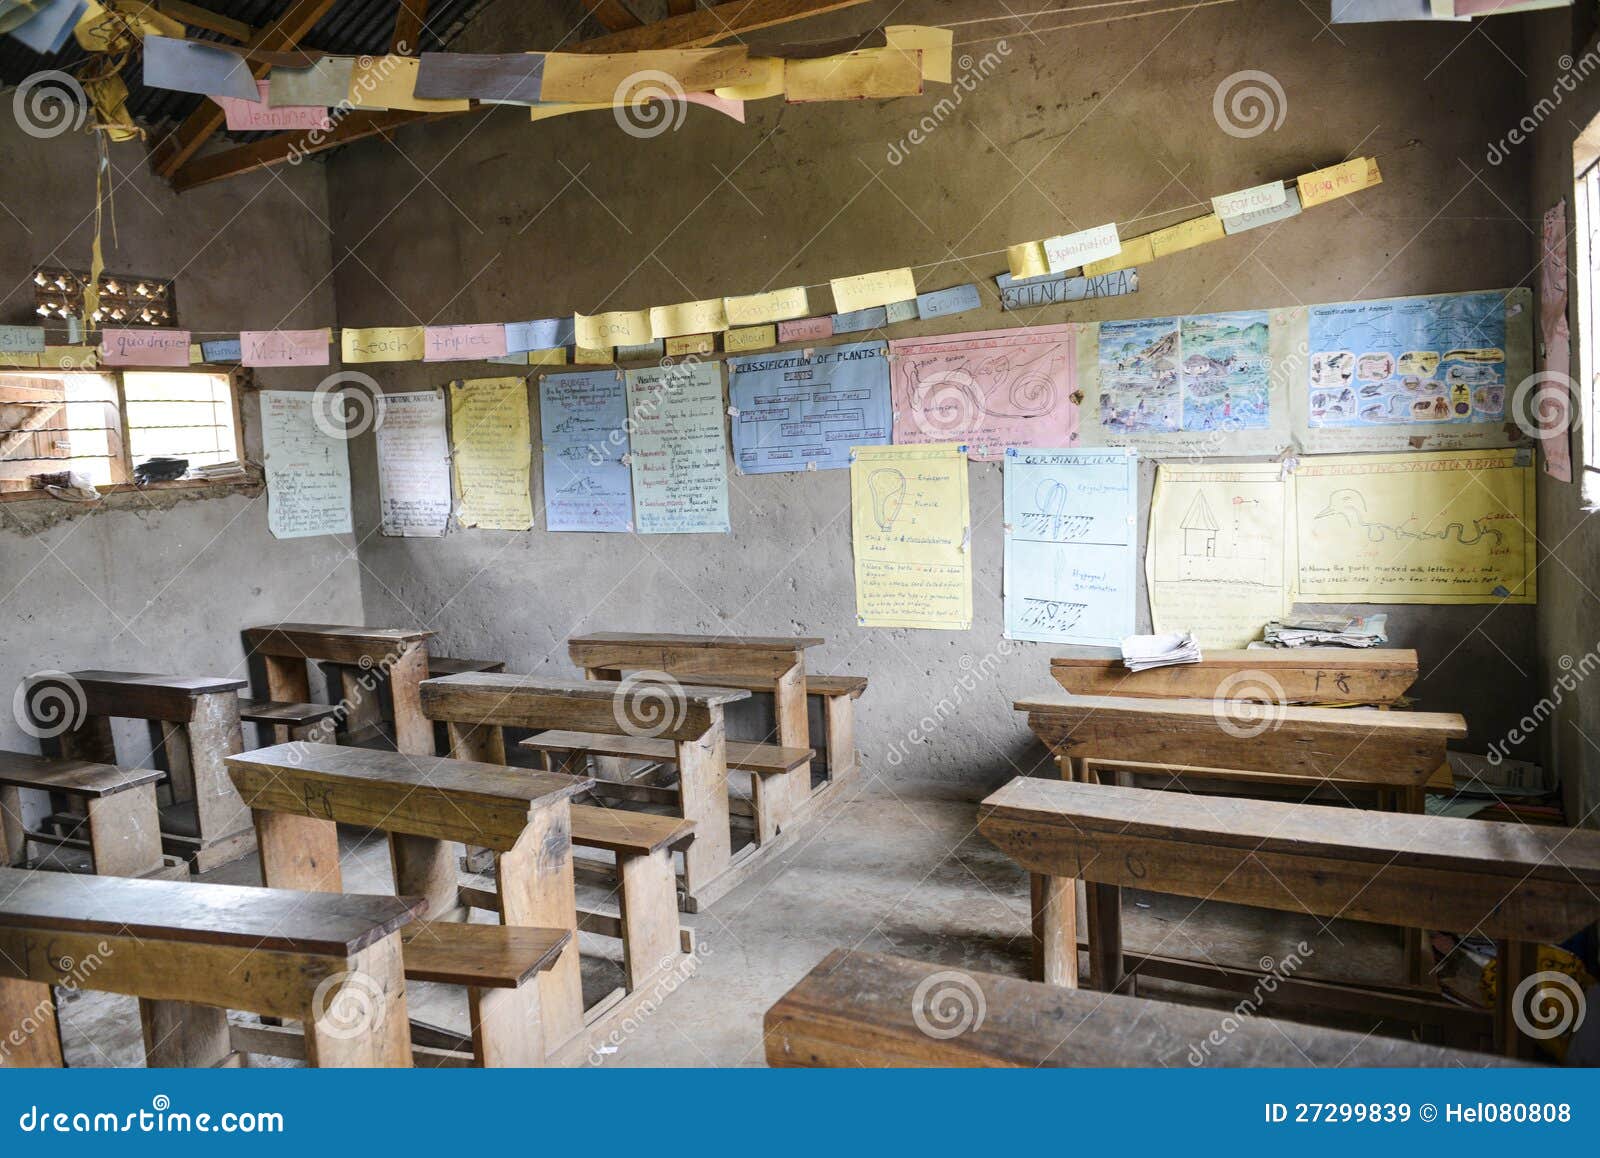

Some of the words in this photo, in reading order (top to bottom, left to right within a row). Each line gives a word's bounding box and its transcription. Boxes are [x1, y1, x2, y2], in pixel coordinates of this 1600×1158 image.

[1004, 279, 1073, 308] SCIENCE
[1083, 270, 1128, 300] AREA
[1313, 307, 1357, 316] Classification
[735, 355, 812, 374] CLASSIFICATION
[816, 353, 831, 364] OF
[837, 349, 875, 362] PLANTS
[1025, 455, 1116, 465] GERMINATION
[1400, 460, 1447, 472] SYSTEM
[1375, 564, 1408, 573] marked
